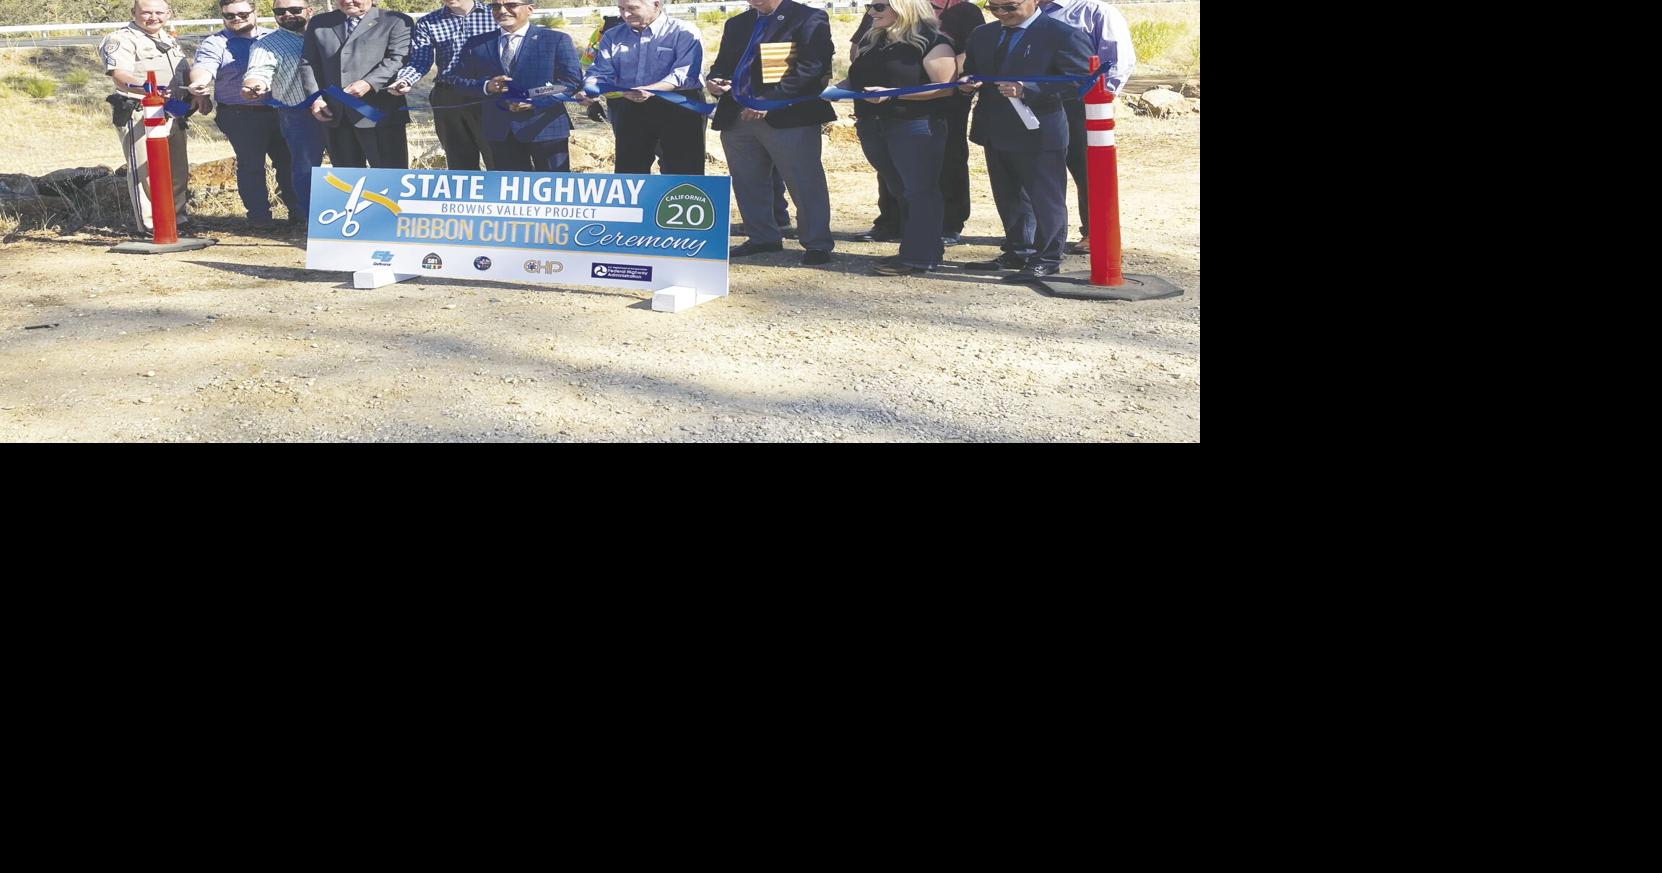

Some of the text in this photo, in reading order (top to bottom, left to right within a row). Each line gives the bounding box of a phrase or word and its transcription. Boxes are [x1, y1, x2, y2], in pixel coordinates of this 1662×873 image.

[400, 174, 645, 205] STATE HIGHWAY
[665, 194, 706, 204] CALIFORNIA
[441, 203, 597, 219] BROWNS VALLEY PROJECT
[666, 203, 705, 226] 20
[396, 217, 707, 257] RIBBON CUTTING Ceremony
